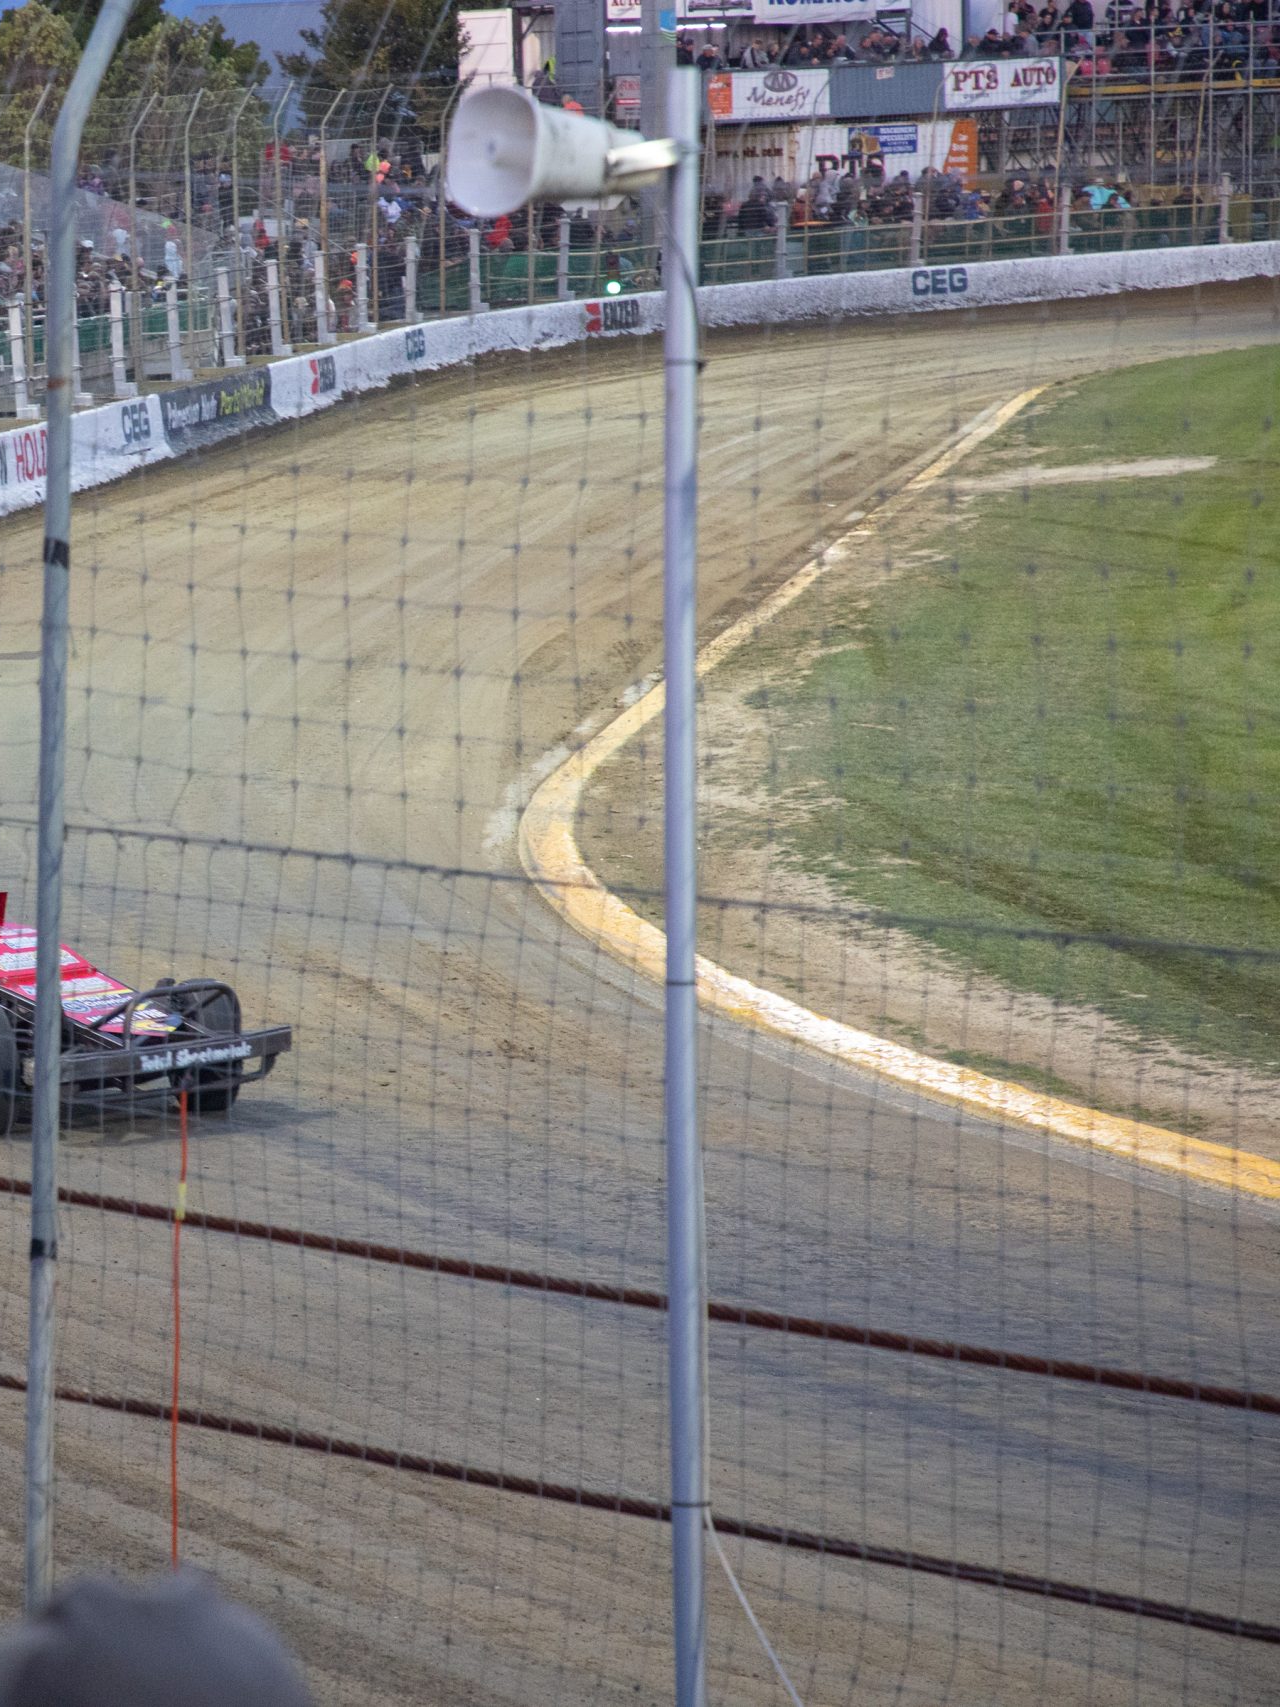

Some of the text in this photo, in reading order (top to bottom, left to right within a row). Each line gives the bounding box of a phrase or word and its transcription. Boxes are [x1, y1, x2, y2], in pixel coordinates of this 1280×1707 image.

[952, 66, 1056, 91] PTS AUTO
[912, 268, 968, 296] CEG
[121, 402, 151, 443] CEG
